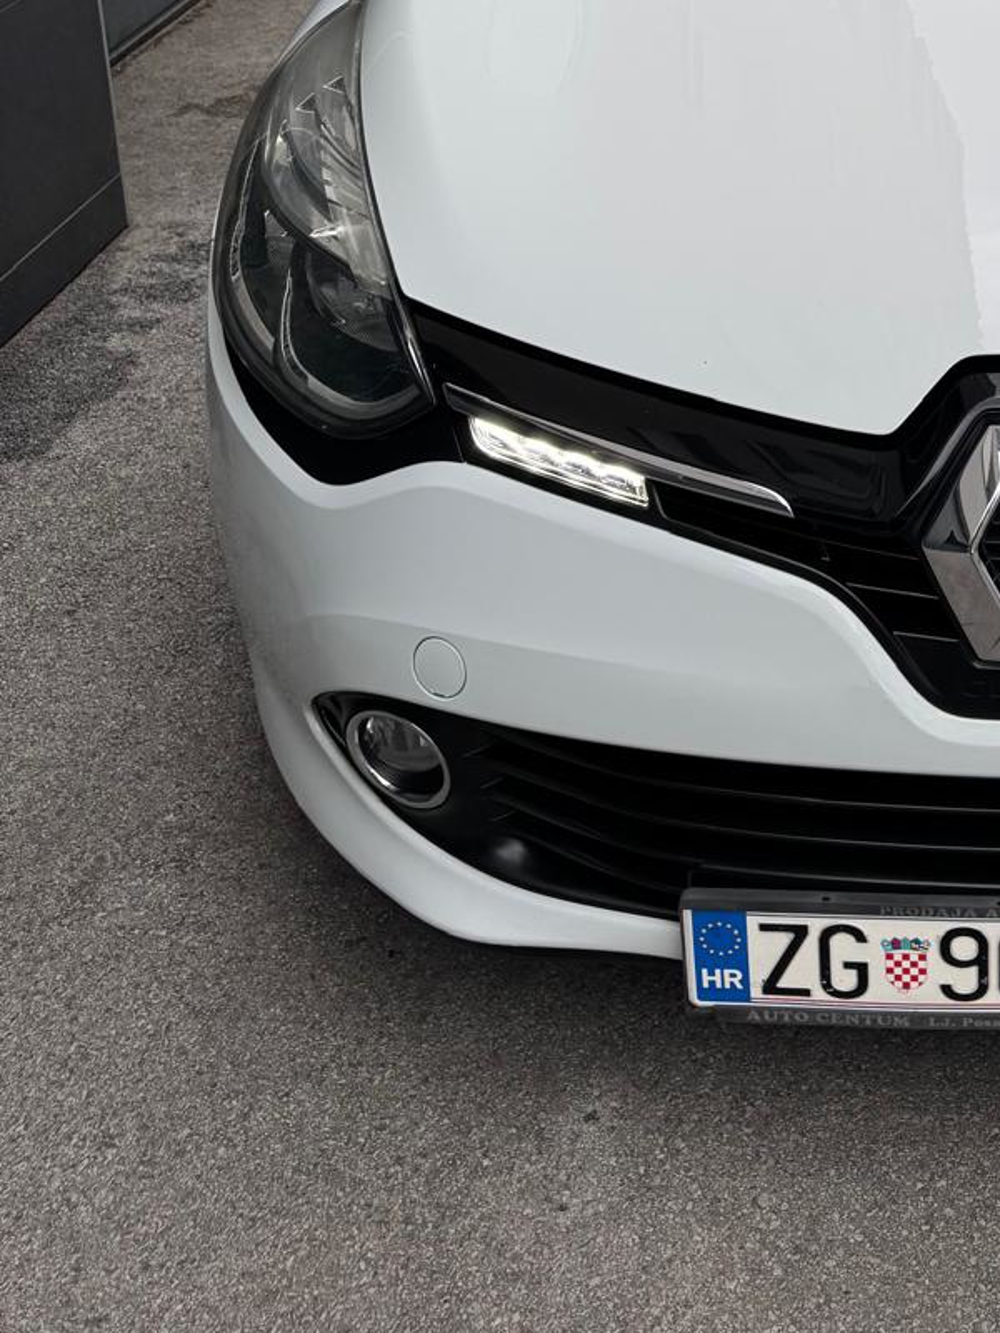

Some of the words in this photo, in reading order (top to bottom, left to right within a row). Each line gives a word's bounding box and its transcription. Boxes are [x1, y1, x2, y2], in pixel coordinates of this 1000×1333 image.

[879, 906, 977, 917] PRODAJA
[758, 923, 870, 1000] ZG
[700, 967, 744, 990] HR
[746, 1010, 809, 1023] AUTO
[815, 1012, 911, 1027] CENTUM
